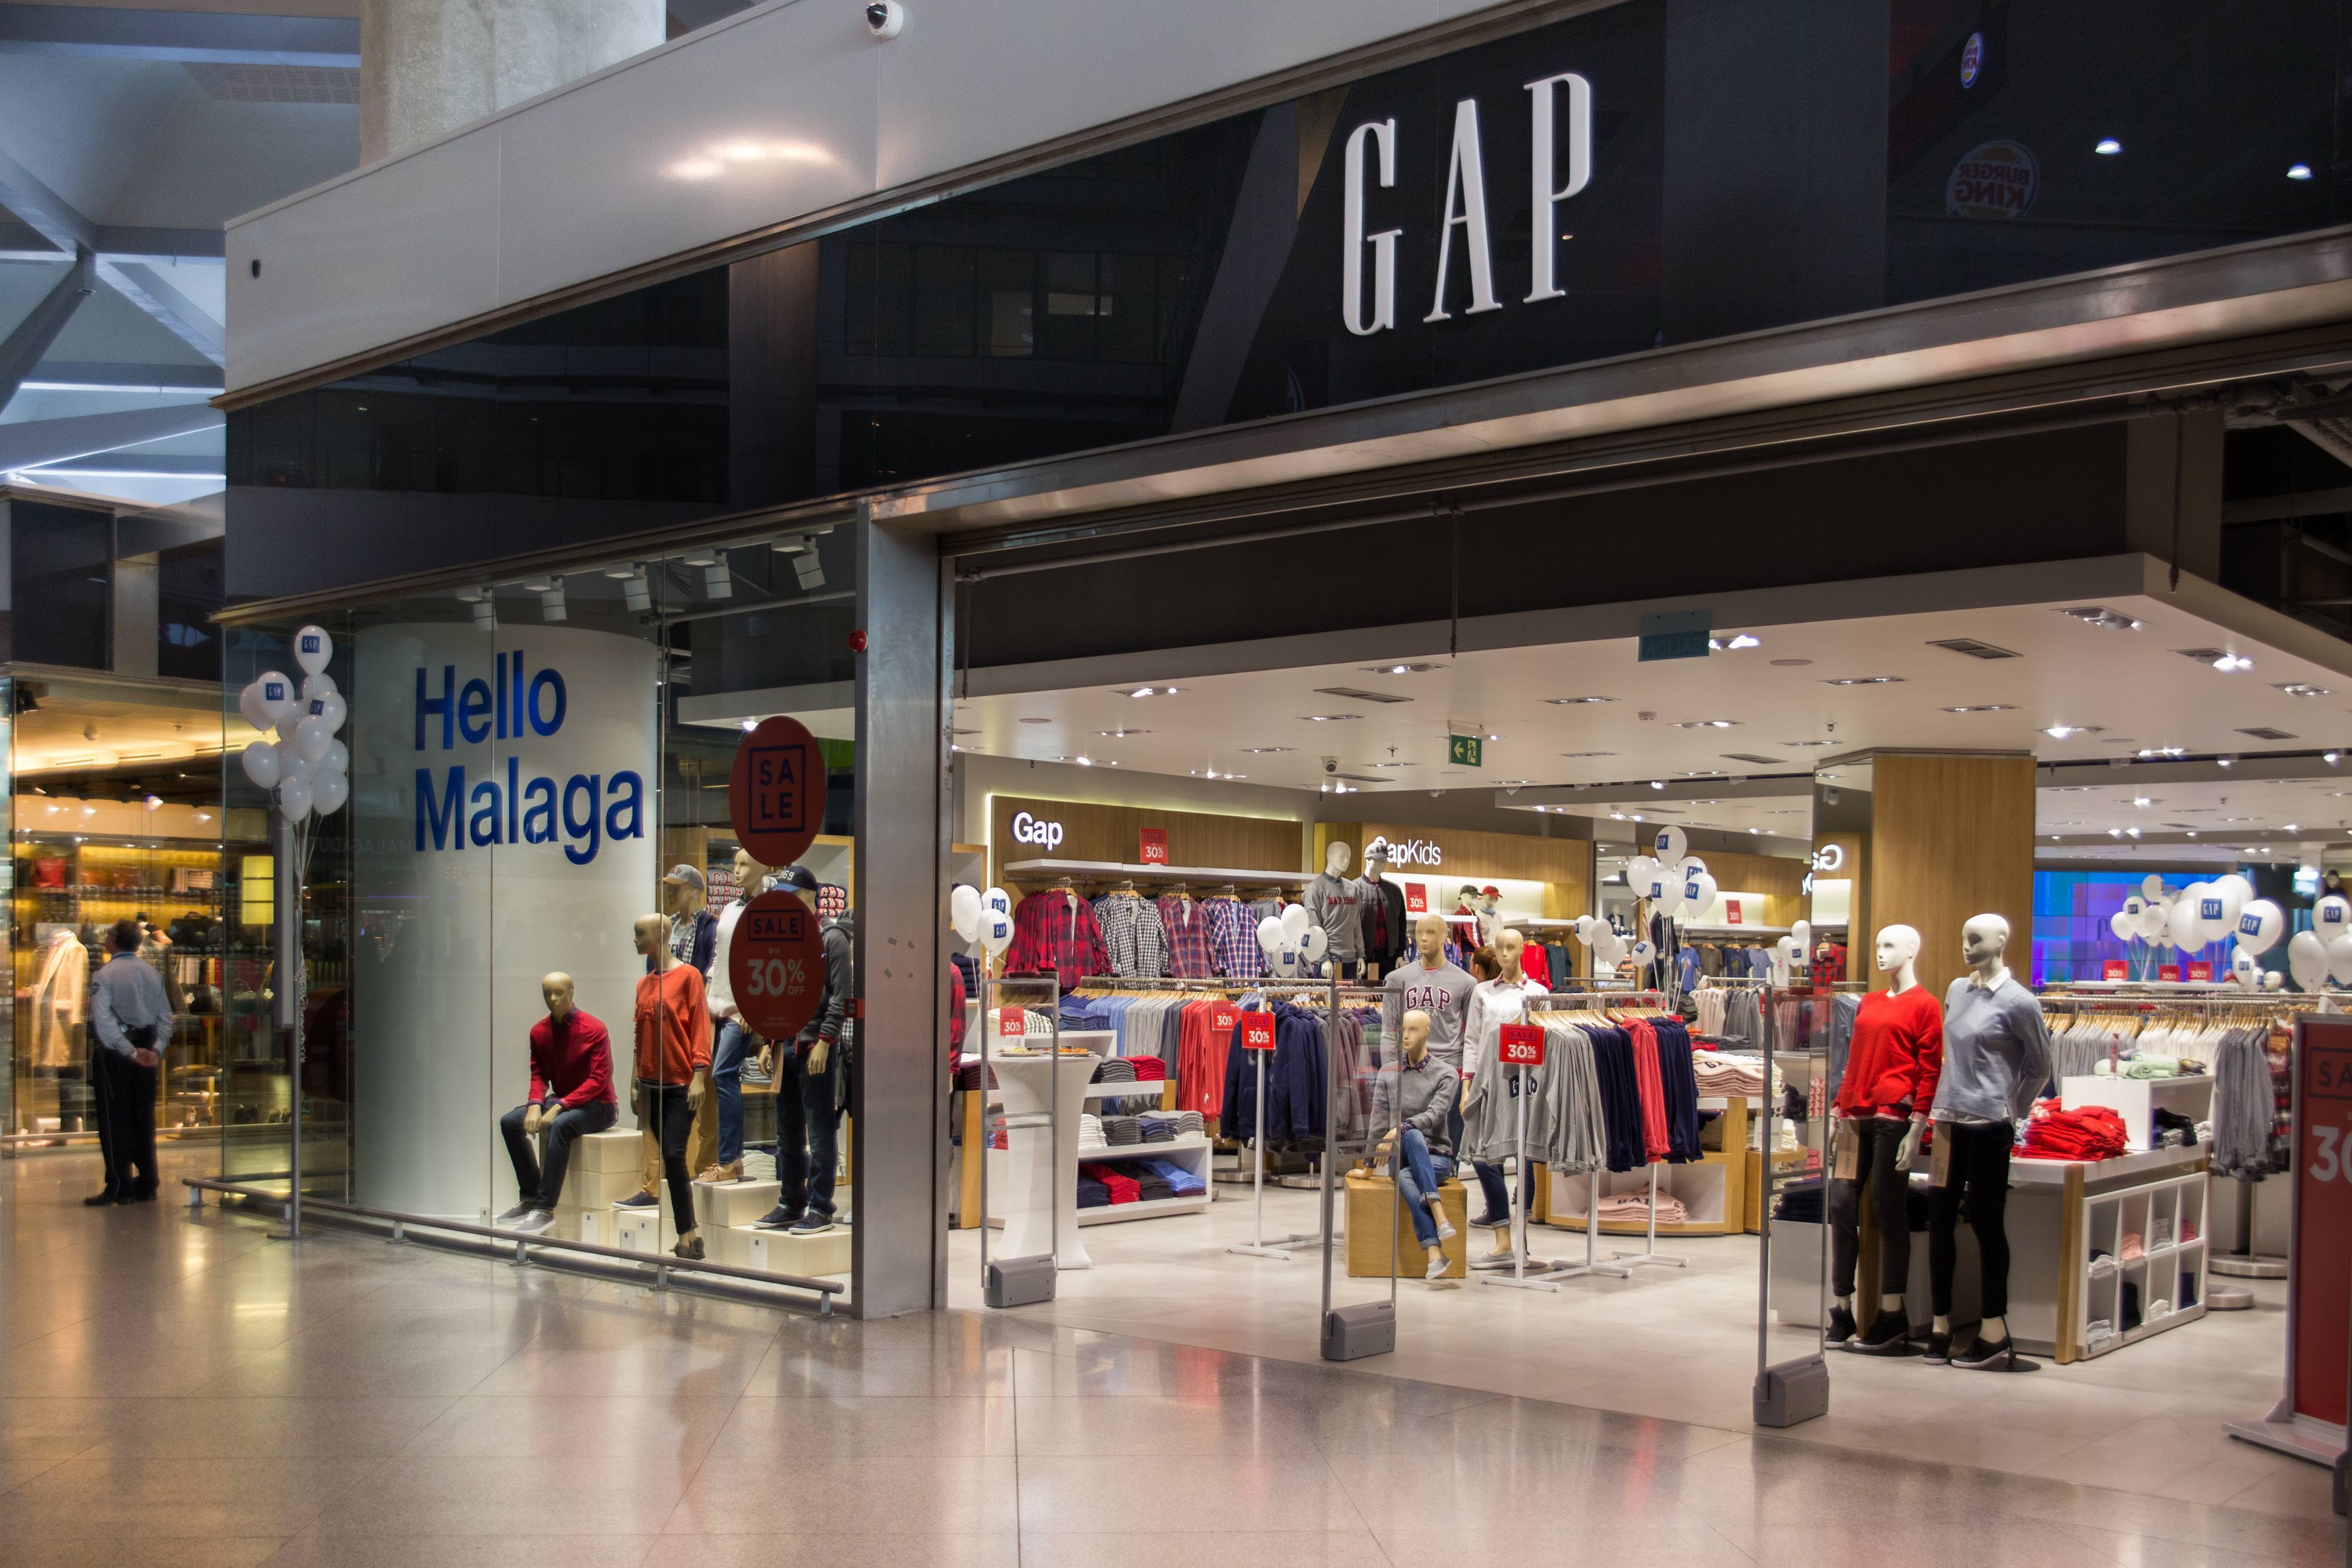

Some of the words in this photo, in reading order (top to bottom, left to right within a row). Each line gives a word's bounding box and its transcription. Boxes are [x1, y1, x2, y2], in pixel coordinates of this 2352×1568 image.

[1343, 73, 1590, 336] GAP
[304, 639, 318, 649] GAP
[269, 686, 282, 697] GAP
[416, 650, 567, 751] Hello
[760, 758, 794, 785] SA
[416, 757, 644, 865] Malaga
[761, 793, 793, 819] LE
[1013, 812, 1063, 851] Gap
[1146, 846, 1163, 858] 30%
[1686, 885, 1696, 895] GAP
[994, 901, 1004, 911] GAP
[2203, 904, 2218, 915] GAP
[2326, 910, 2338, 920] GAP
[754, 917, 799, 934] SALE
[996, 926, 1005, 935] GAP
[2241, 917, 2258, 931] GAP
[747, 958, 805, 996] 30%
[788, 986, 804, 995] OFF
[1405, 985, 1452, 1011] GAP
[1004, 1021, 1021, 1032] 30%
[1217, 1015, 1232, 1025] 30%
[1248, 1030, 1269, 1043] 30%
[1508, 1044, 1536, 1058] 30%
